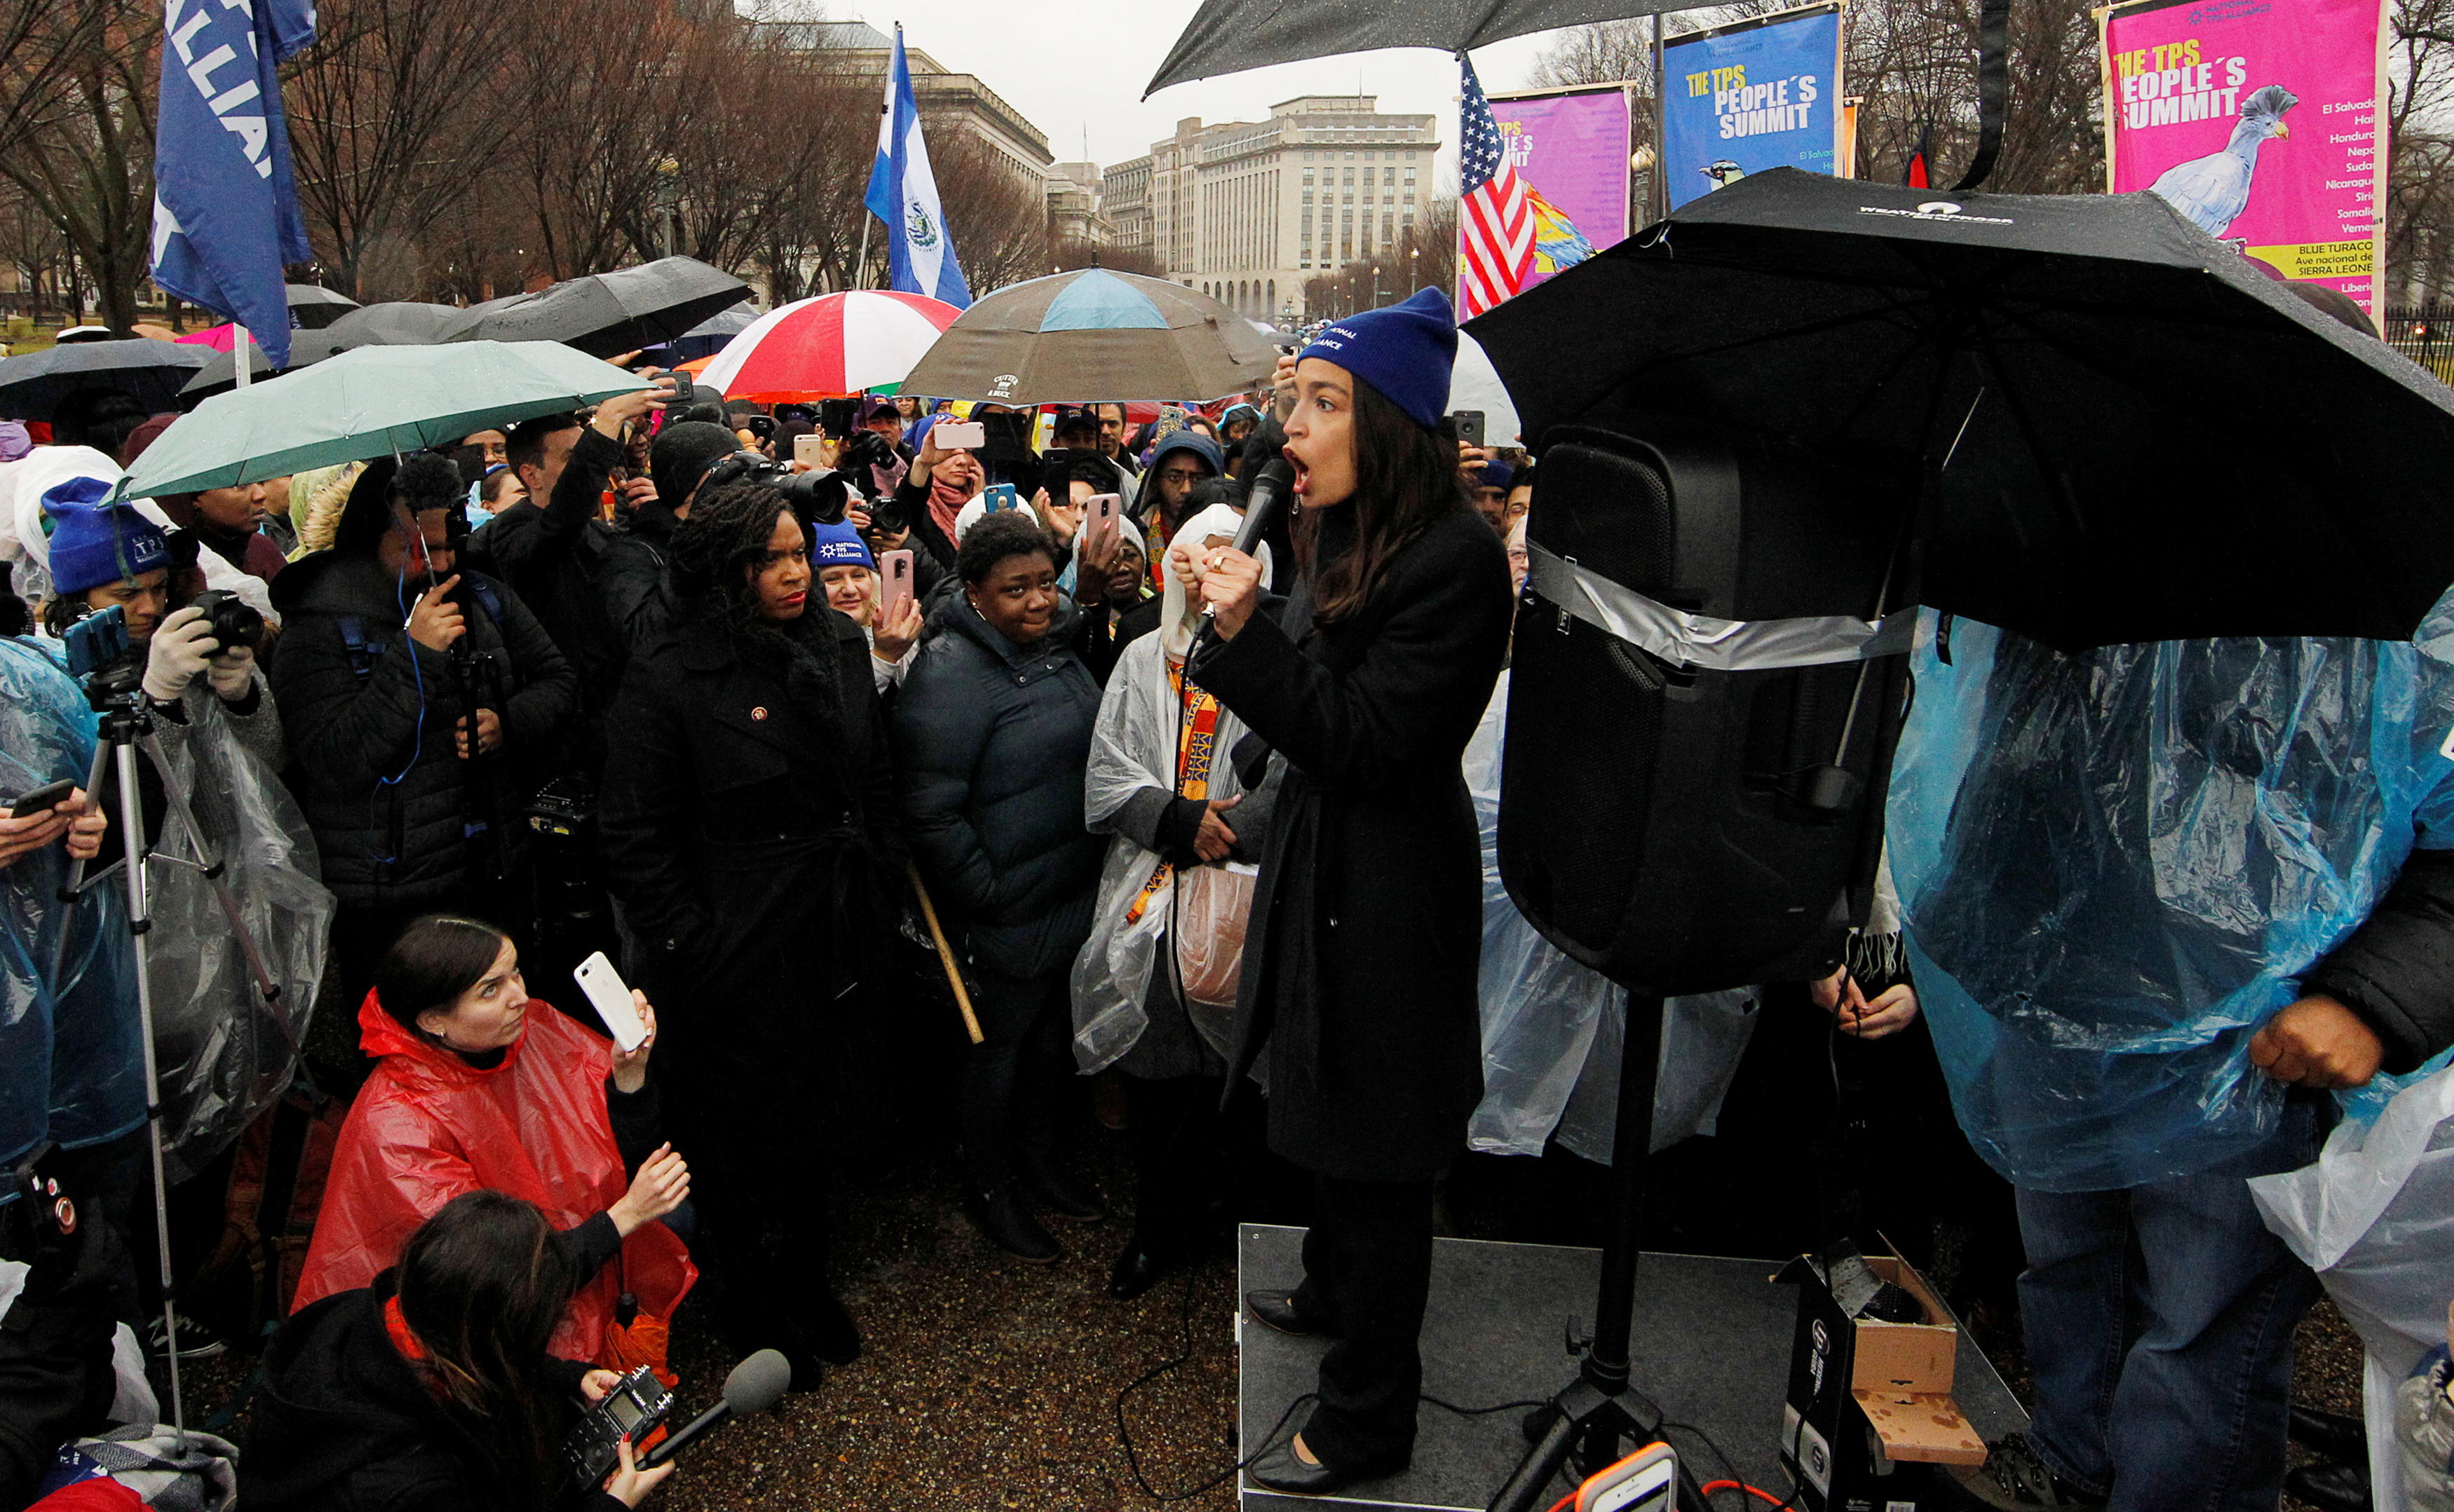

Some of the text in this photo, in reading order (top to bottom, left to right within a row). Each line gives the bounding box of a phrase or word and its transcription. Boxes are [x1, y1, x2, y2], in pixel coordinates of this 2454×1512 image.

[2225, 3, 2271, 20] ALLIANCE
[2153, 39, 2200, 73] TPS
[1686, 64, 1747, 98] THE TPS
[2323, 104, 2332, 114] El
[1719, 102, 1812, 140] SUMMIT
[2354, 114, 2375, 125] Hai
[2346, 161, 2375, 173] Suda
[2300, 241, 2373, 254] BLUE TURACO
[2316, 253, 2357, 264] nacional
[2361, 253, 2373, 261] de
[2299, 264, 2373, 275] SIERRA LEONE
[994, 374, 1019, 386] CUTTER
[993, 390, 1011, 399] BUCK
